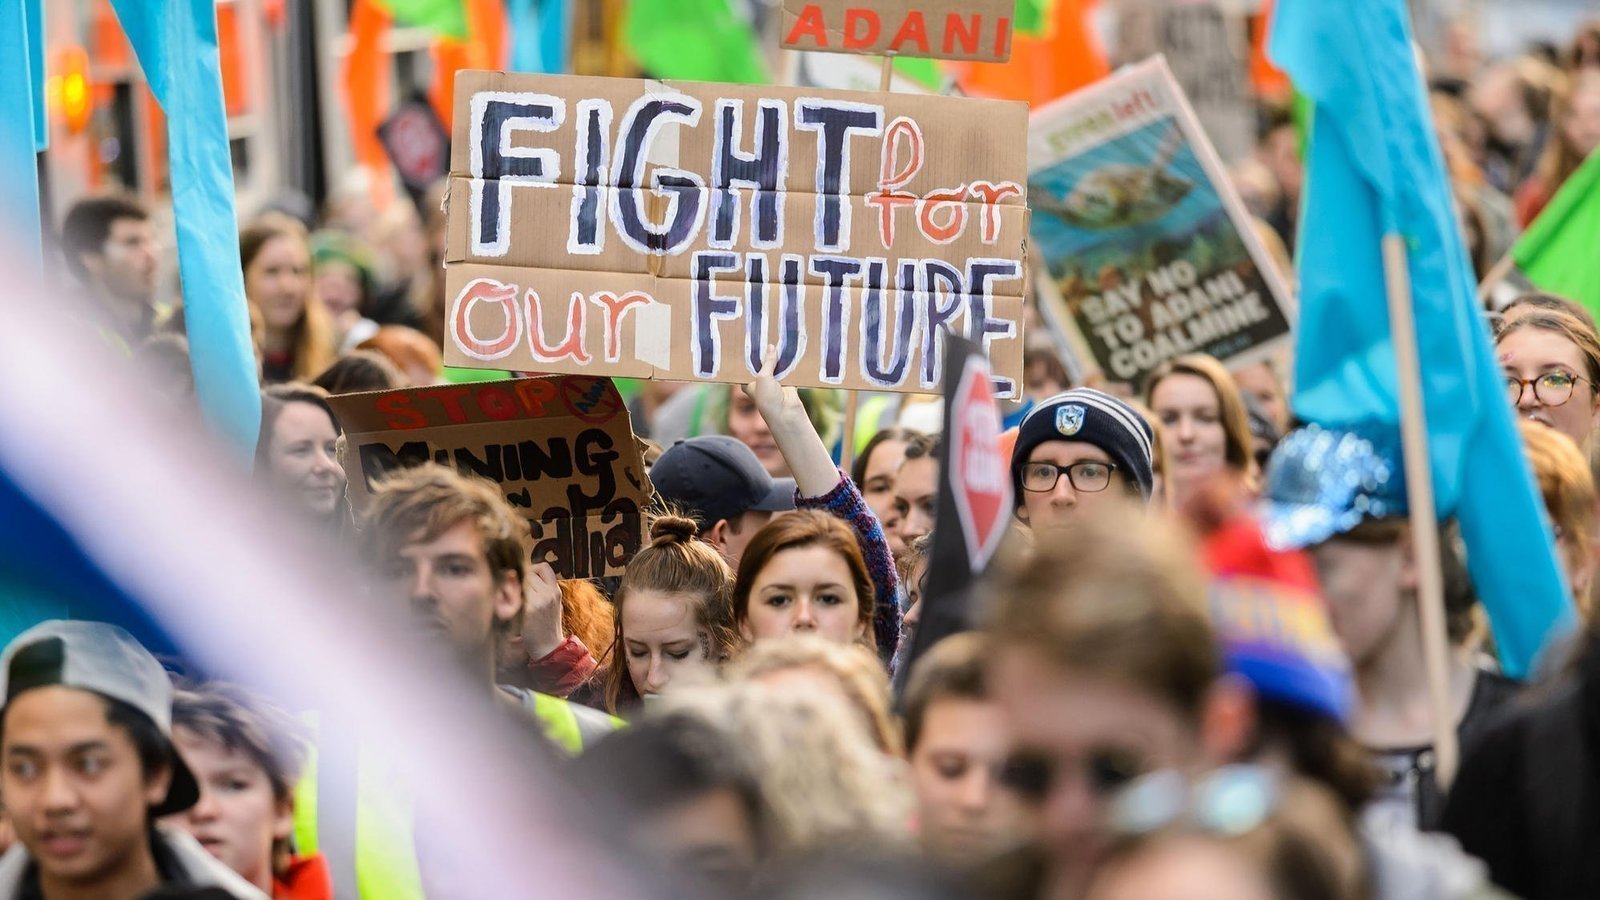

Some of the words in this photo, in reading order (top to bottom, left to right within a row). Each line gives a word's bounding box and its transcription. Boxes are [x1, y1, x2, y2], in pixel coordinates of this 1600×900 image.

[784, 4, 1009, 57] ADANI
[469, 91, 884, 256] FIGHT
[865, 117, 1023, 249] for
[450, 278, 657, 366] our
[691, 251, 1023, 398] FUTURE
[1080, 279, 1142, 325] SAY
[1147, 260, 1197, 298] NO
[1093, 313, 1144, 351] TO
[1150, 270, 1246, 331] ADANI
[1110, 291, 1270, 379] COALMINE
[375, 380, 559, 431] STOP
